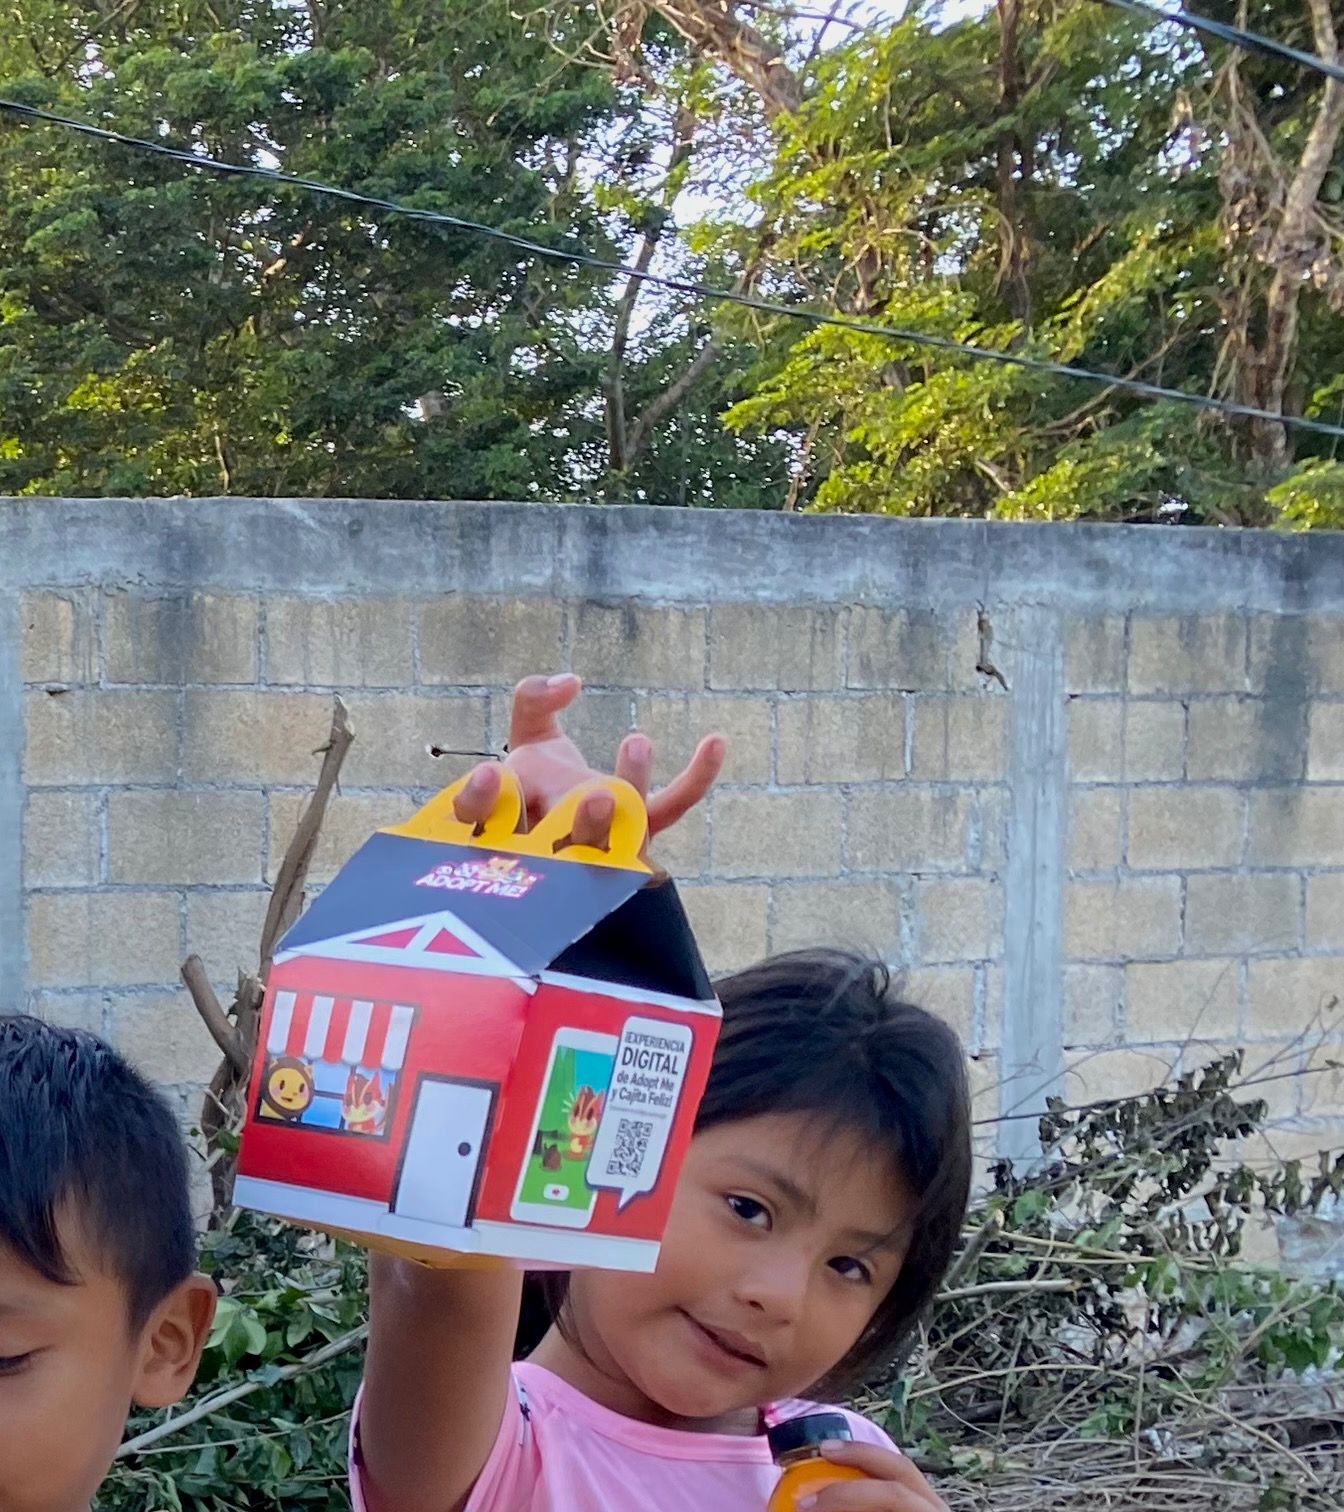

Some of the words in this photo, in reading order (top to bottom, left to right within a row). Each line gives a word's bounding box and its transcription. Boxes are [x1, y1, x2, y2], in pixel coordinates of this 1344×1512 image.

[415, 872, 491, 893] ADOPT
[621, 1046, 679, 1076] DIGITAL
[616, 1069, 629, 1084] de
[629, 1072, 660, 1091] Adopt
[660, 1077, 675, 1092] Me
[610, 1088, 618, 1102] y
[619, 1086, 647, 1106] Cajita
